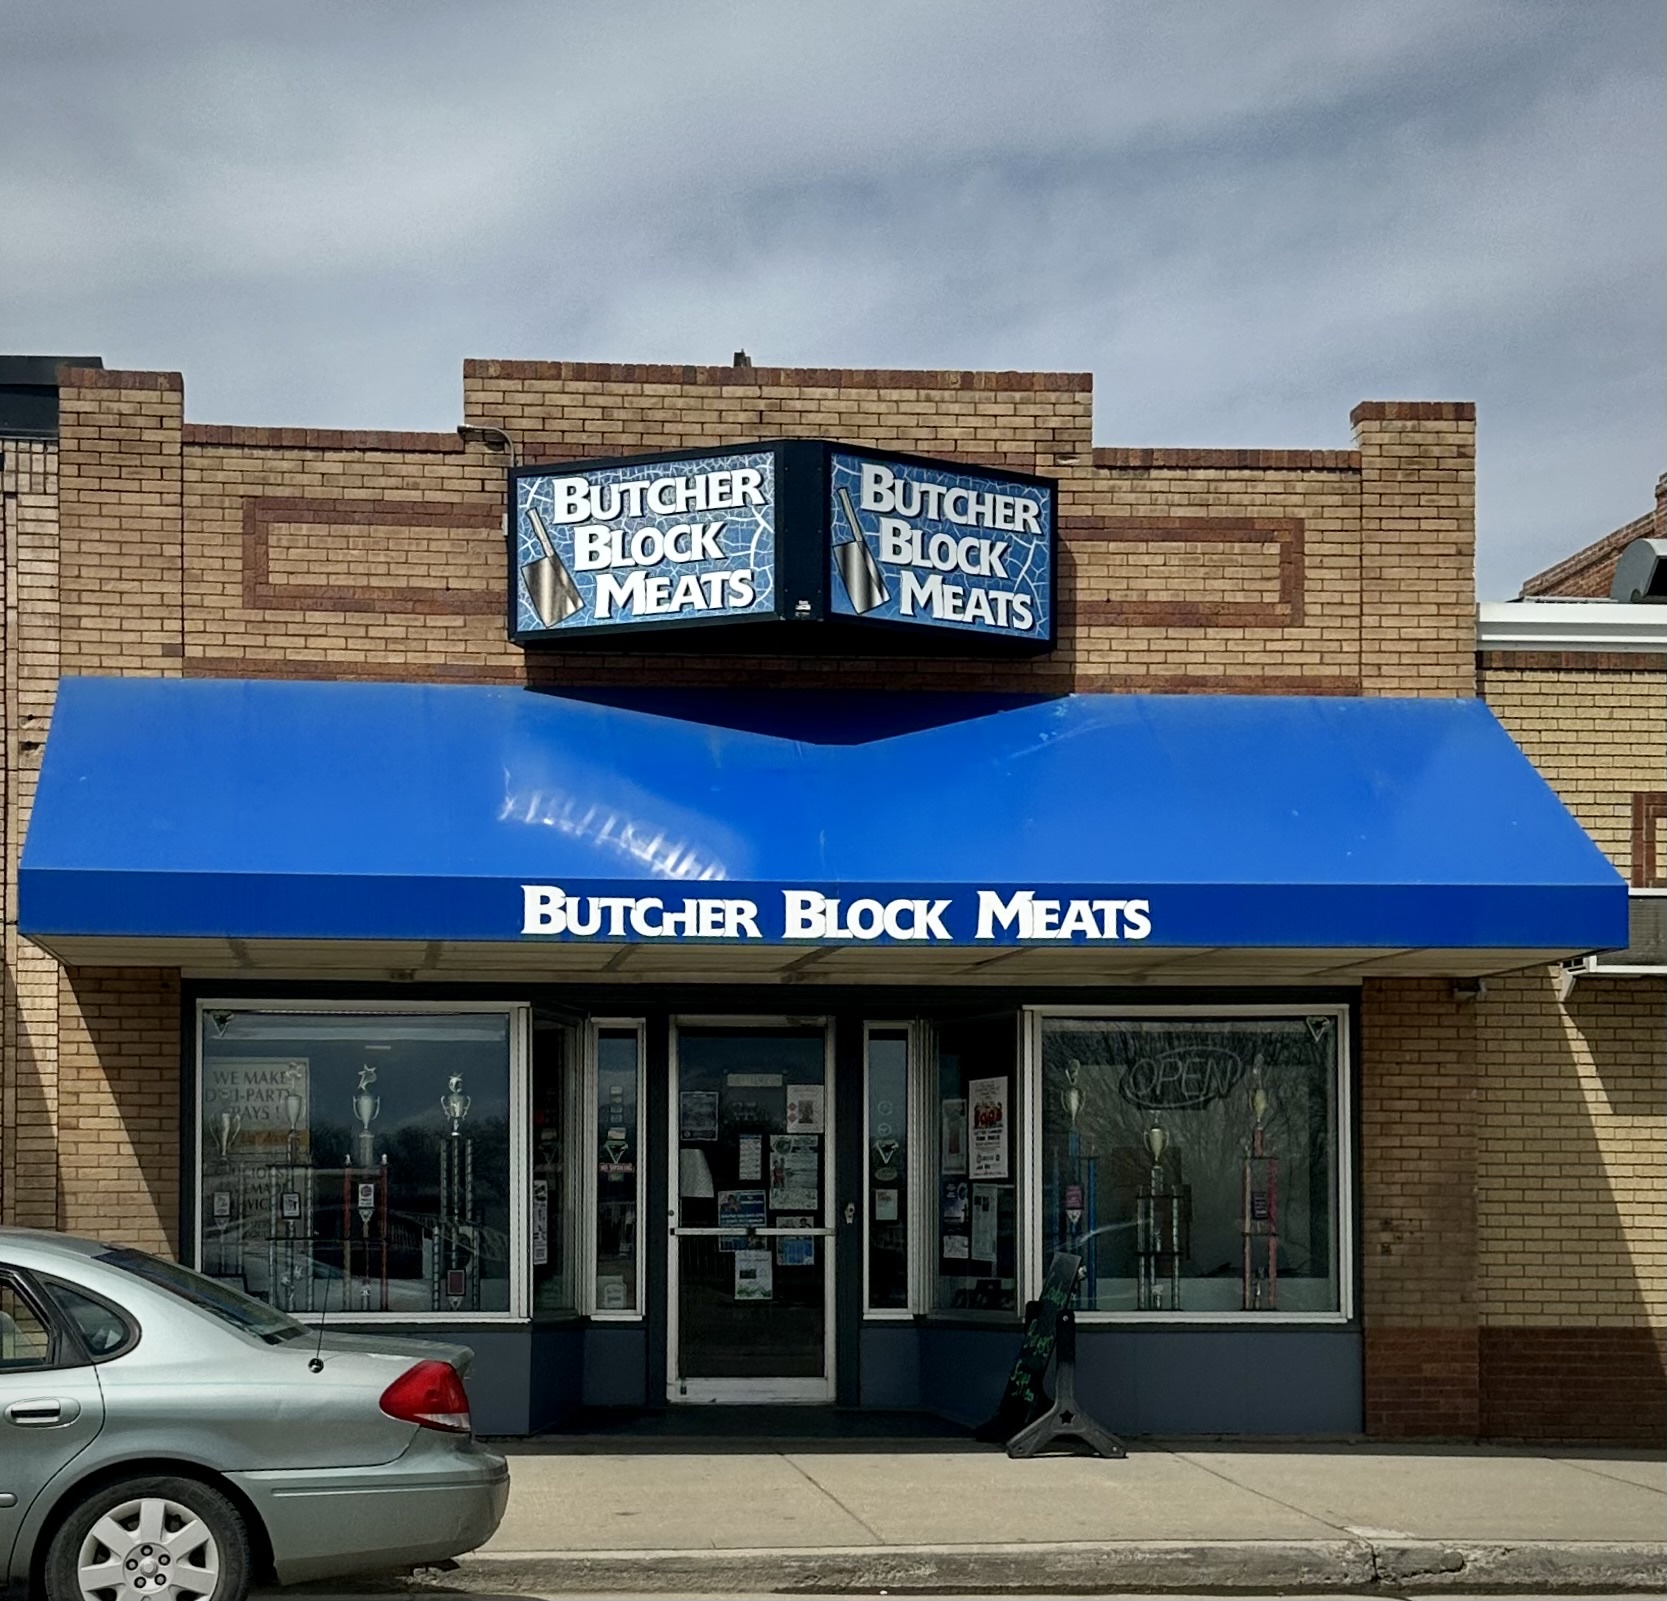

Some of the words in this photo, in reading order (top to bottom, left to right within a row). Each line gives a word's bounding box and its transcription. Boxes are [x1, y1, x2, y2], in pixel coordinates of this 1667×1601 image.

[552, 468, 766, 525] BUTCHER
[860, 463, 1043, 535] BUTCHER
[574, 521, 727, 572] BLOCK
[879, 516, 1010, 579] BLOCK
[594, 569, 755, 619] MEATS
[899, 570, 1034, 630] MEATS
[521, 885, 762, 939] BUTCHER
[782, 889, 953, 941] BLOCK
[976, 890, 1152, 941] MEATS
[205, 1088, 291, 1103] DI-PARTY
[212, 1071, 240, 1085] WE
[244, 1071, 288, 1085] MAKE
[1129, 1057, 1233, 1097] OPEN
[223, 1105, 270, 1120] RAYS
